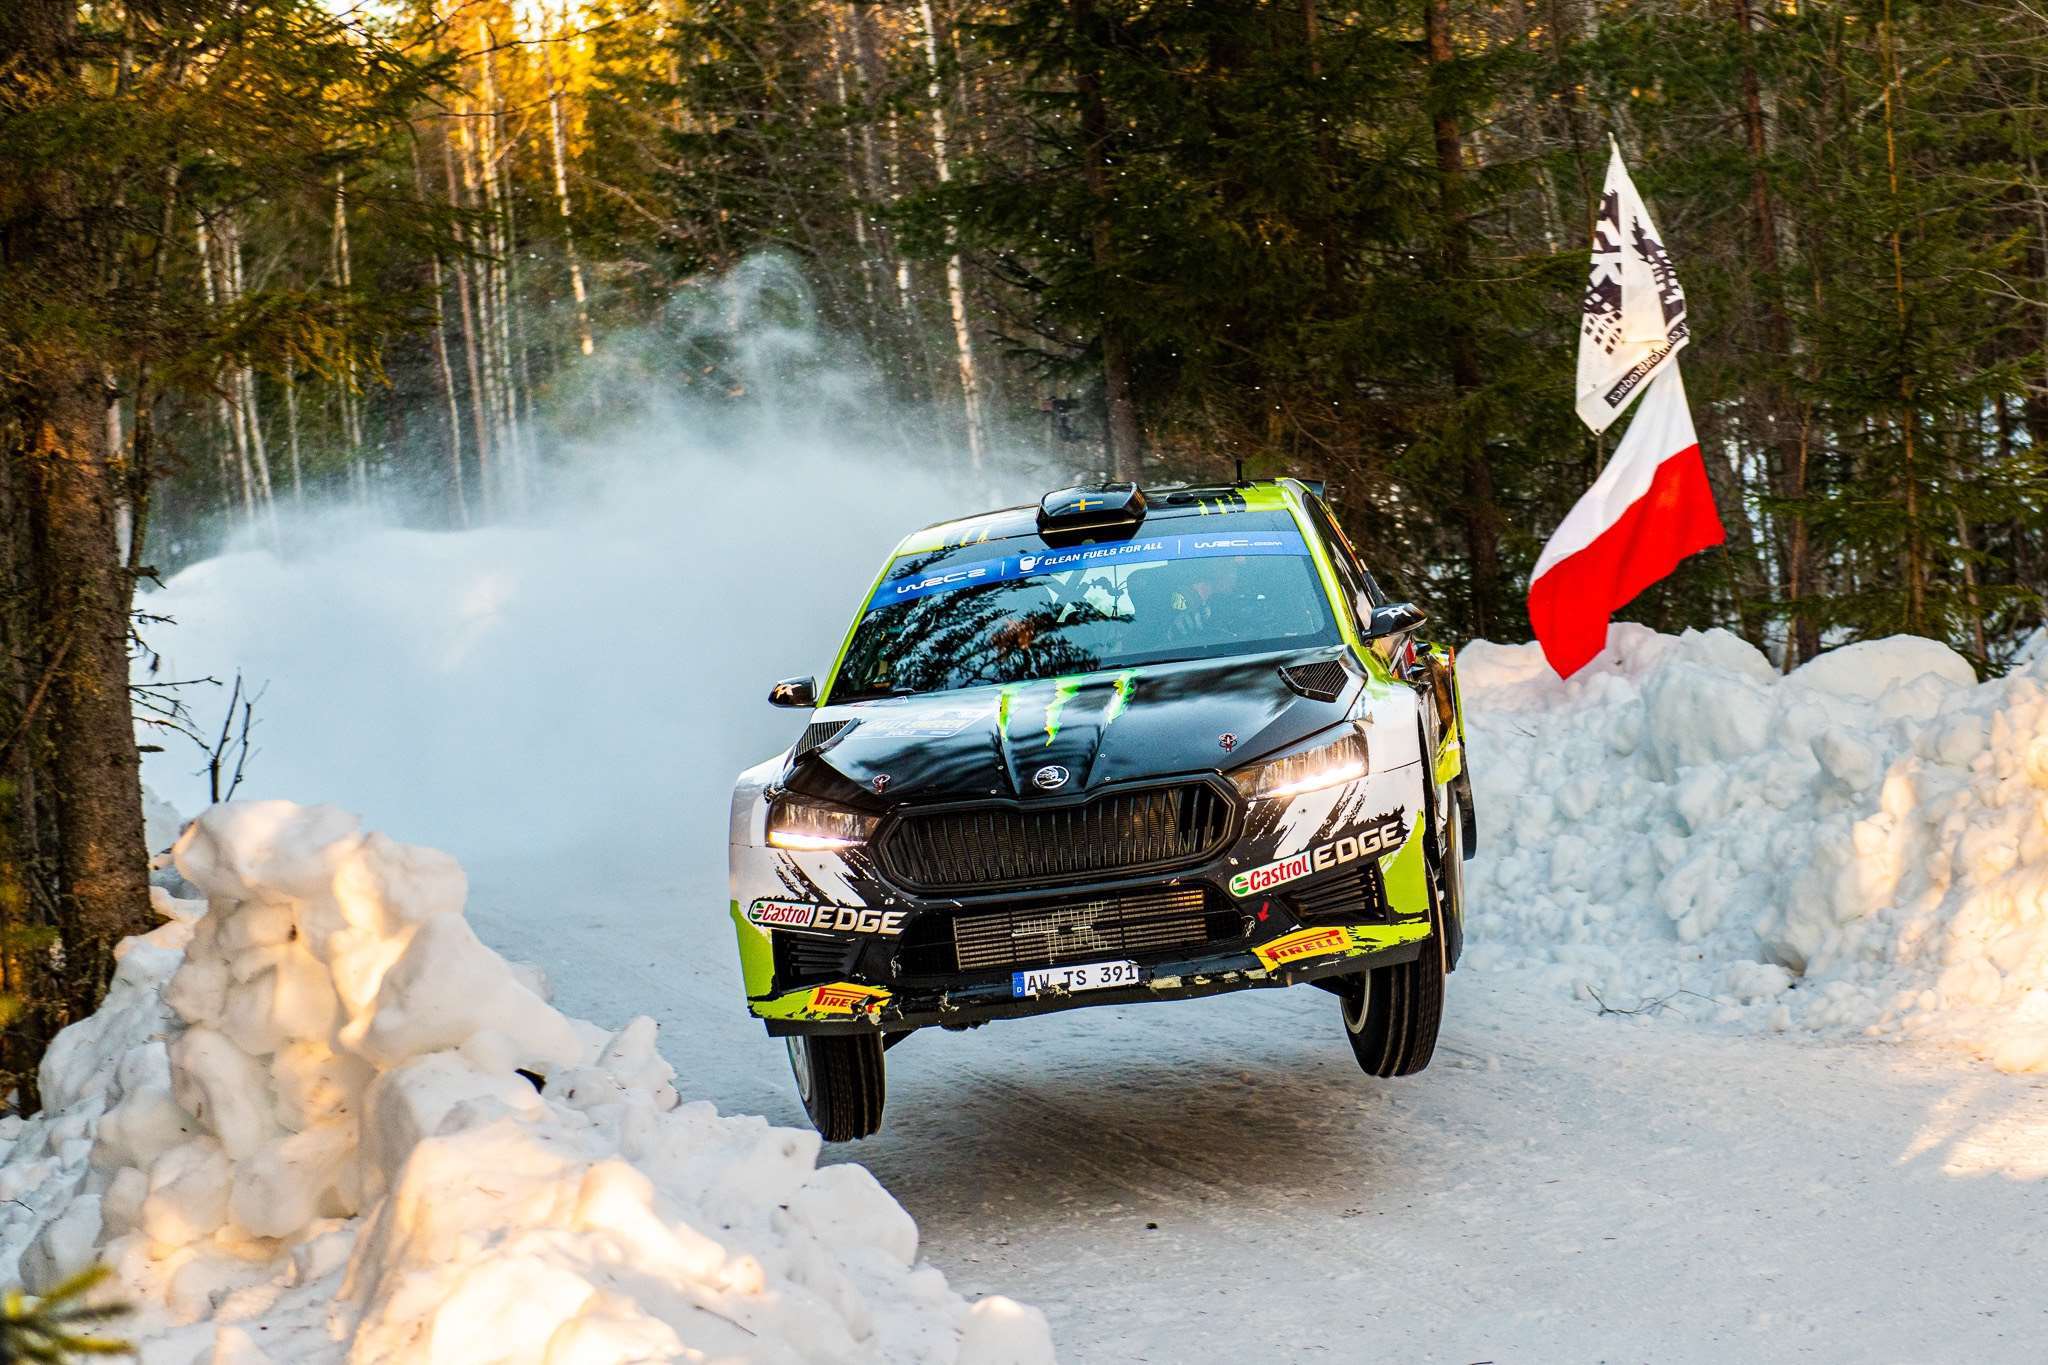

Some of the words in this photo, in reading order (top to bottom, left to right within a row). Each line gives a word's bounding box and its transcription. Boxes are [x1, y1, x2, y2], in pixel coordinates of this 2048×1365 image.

[1044, 554, 1080, 566] CLEAN
[1082, 548, 1117, 560] FUELS
[1119, 544, 1141, 554] FOR
[1143, 541, 1163, 550] ALL
[896, 568, 986, 594] WRC2
[1250, 855, 1310, 891] Castrol
[1312, 821, 1403, 872] EDGE
[762, 903, 811, 924] Castrol
[811, 905, 908, 935] EDGE
[1265, 930, 1344, 960] PIRELLI
[1100, 965, 1136, 983] 391
